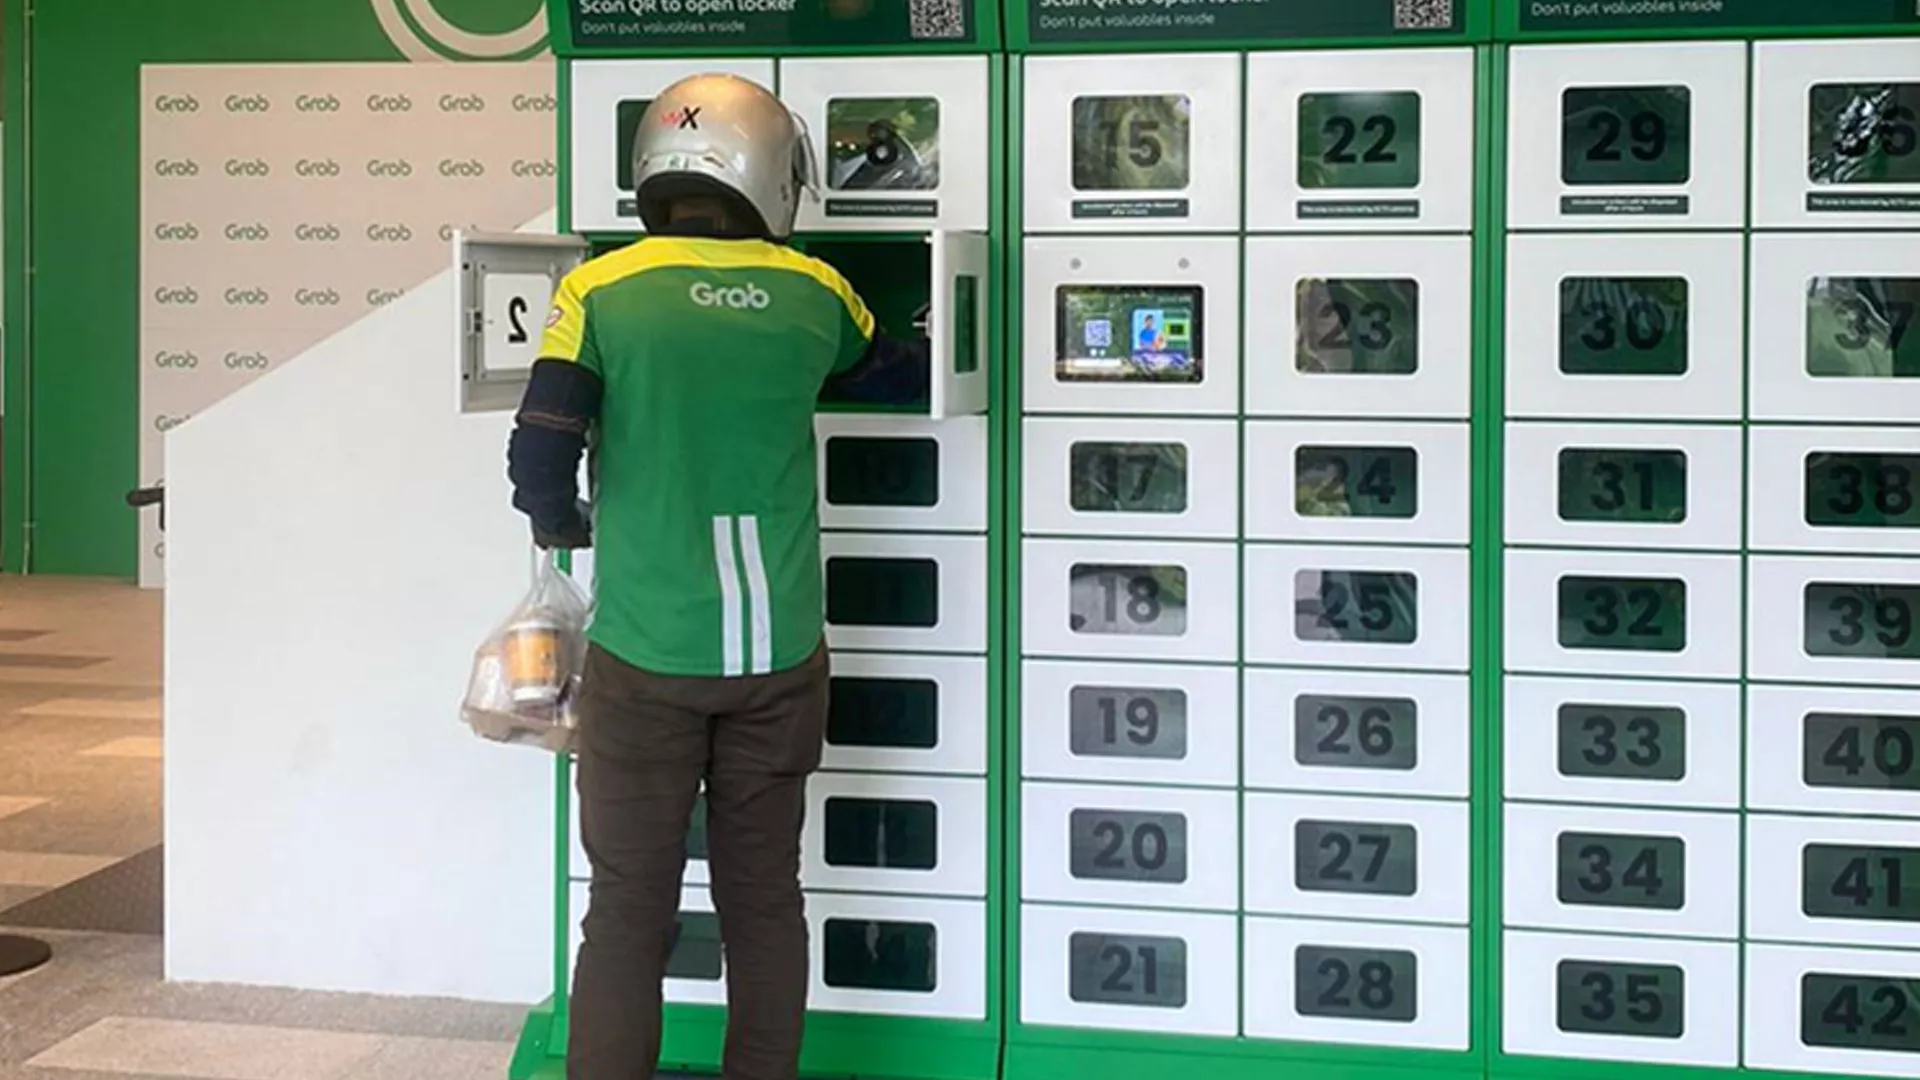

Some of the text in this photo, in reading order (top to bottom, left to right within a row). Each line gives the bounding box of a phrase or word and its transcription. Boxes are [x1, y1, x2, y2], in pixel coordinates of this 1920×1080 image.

[580, 0, 796, 16] Scan QR to open locker
[709, 19, 746, 33] inside
[1078, 15, 1103, 29] put
[1105, 13, 1172, 27] valuables
[1174, 12, 1215, 26] inside
[154, 93, 200, 113] Grab
[223, 93, 271, 113] Grab
[294, 93, 341, 113] Grab
[366, 93, 413, 113] Grab
[438, 93, 485, 113] Grab
[511, 93, 558, 113] Grab
[867, 117, 897, 167] 8
[1103, 120, 1163, 168] 15
[1322, 114, 1397, 165] 22
[1585, 110, 1667, 162] 29
[154, 158, 200, 177] Grab
[224, 158, 270, 177] Grab
[294, 158, 341, 177] Grab
[366, 158, 413, 177] Grab
[438, 158, 485, 177] Grab
[511, 158, 557, 177] Grab
[154, 222, 199, 241] Grab
[223, 222, 270, 241] Grab
[294, 223, 341, 242] Grab
[366, 223, 413, 242] Grab
[154, 285, 199, 305] Grab
[223, 287, 269, 305] Grab
[294, 287, 341, 306] Grab
[690, 281, 770, 309] Grab
[1317, 301, 1395, 351] 23
[1579, 301, 1665, 352] 30
[154, 350, 199, 369] Grab
[223, 351, 269, 370] Grab
[1315, 454, 1397, 506] 24
[1590, 460, 1655, 512] 31
[1826, 463, 1914, 517] 38
[1098, 575, 1162, 624] 18
[1316, 580, 1394, 631] 25
[1583, 586, 1664, 638] 32
[1827, 595, 1913, 648] 39
[1097, 696, 1160, 746] 19
[1316, 705, 1395, 757] 26
[1580, 715, 1662, 768] 33
[1822, 725, 1914, 778] 40
[1092, 820, 1168, 871] 20
[1317, 830, 1393, 883] 27
[1576, 843, 1663, 897] 34
[1830, 857, 1901, 908] 41
[1100, 944, 1158, 996] 21
[1316, 957, 1395, 1011] 28
[1579, 971, 1664, 1025] 35
[1820, 984, 1908, 1037] 42
